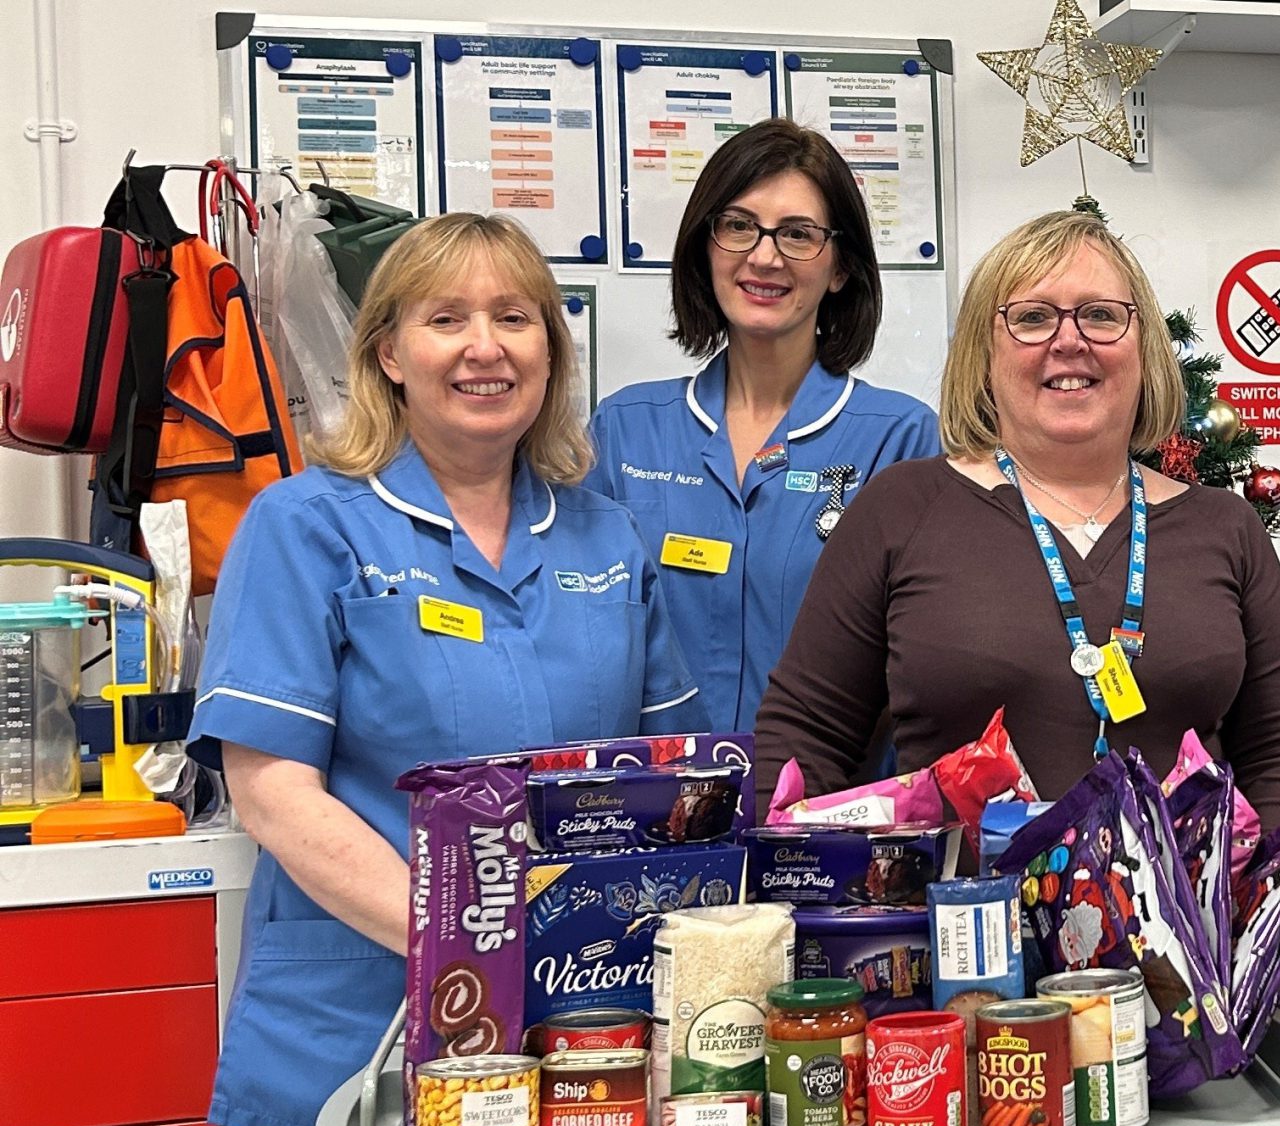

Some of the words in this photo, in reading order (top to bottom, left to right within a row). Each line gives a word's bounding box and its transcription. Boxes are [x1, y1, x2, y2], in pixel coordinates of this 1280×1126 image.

[621, 462, 672, 482] Registered
[675, 473, 704, 486] Nurse
[790, 475, 810, 486] HSC
[1131, 483, 1145, 506] NHS
[1034, 523, 1053, 548] NHS
[1133, 511, 1146, 536] NHS
[1132, 540, 1146, 565] NHS
[559, 575, 581, 588] HSC
[1046, 556, 1066, 584] NHS
[1131, 570, 1145, 596] NHS
[1108, 667, 1124, 696] Sharon
[575, 792, 626, 809] Cadbury
[557, 817, 601, 836] Sticky
[601, 816, 637, 831] Puds
[441, 844, 450, 883] VANILLA
[450, 844, 458, 875] JUMBO
[502, 856, 520, 881] Ms
[774, 847, 821, 865] Cadbury
[151, 870, 212, 889] MEDISCO
[462, 824, 518, 952] Molly's
[761, 872, 802, 889] Sticky
[802, 874, 835, 889] Puds
[440, 886, 450, 915] SWISS
[449, 878, 458, 931] CHOCOLATE
[440, 916, 448, 941] ROLL
[957, 910, 969, 935] TEA
[957, 938, 969, 975] RICH
[697, 1022, 764, 1039] GROWER'S
[699, 1036, 762, 1051] HARVEST
[988, 1050, 1047, 1076] HOT
[553, 1081, 588, 1102] Ship
[808, 1072, 840, 1089] FOOD
[978, 1075, 1047, 1101] DOGS
[696, 1108, 728, 1117] TESCO
[803, 1105, 839, 1116] TOMATO
